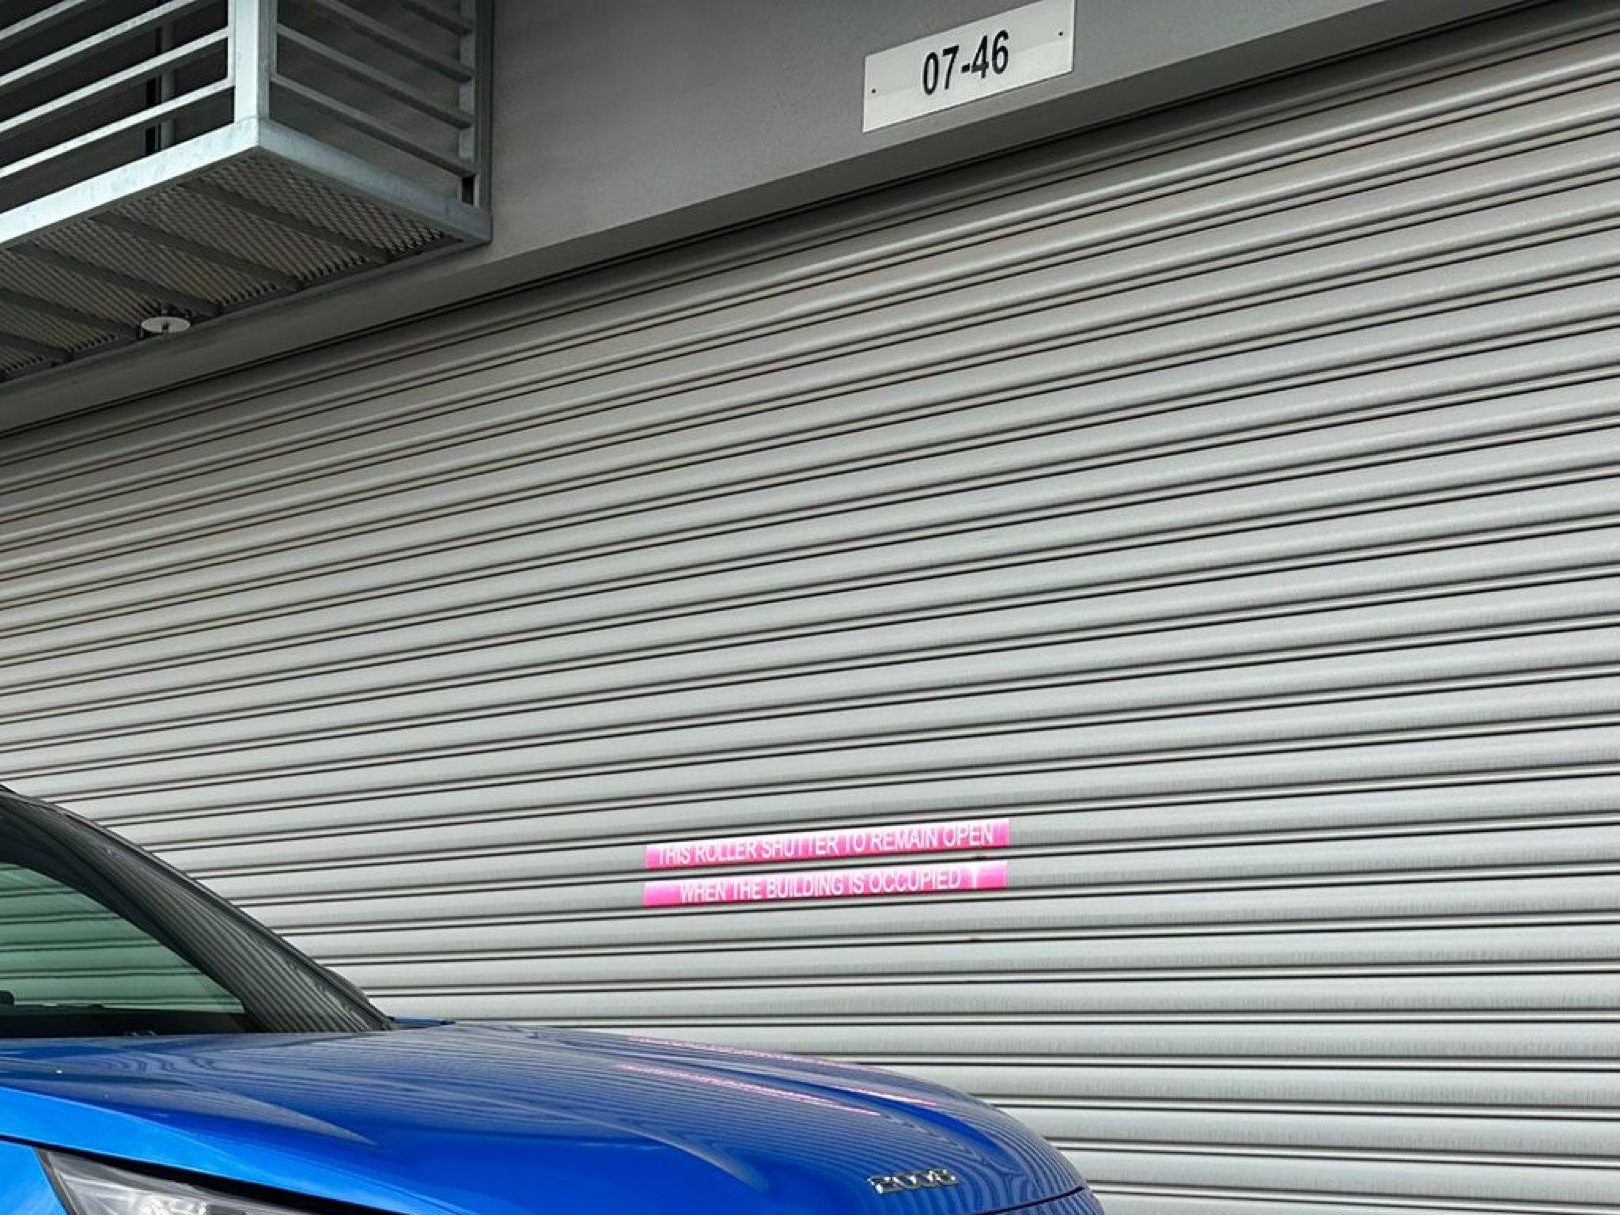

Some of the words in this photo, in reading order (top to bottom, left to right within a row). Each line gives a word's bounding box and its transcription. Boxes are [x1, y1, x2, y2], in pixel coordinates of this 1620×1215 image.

[923, 29, 1009, 95] 07-46
[658, 844, 690, 866] THIS
[695, 838, 757, 863] ROLLER
[761, 833, 839, 860] SHUTTER
[844, 831, 867, 853] TO
[871, 826, 939, 851] REMAIN
[943, 822, 994, 847] OPEN
[681, 880, 727, 903] WHEN
[731, 877, 763, 901] THE
[766, 872, 844, 899] BUILDING
[847, 872, 865, 895] IS
[869, 867, 961, 893] OCCUPIED
